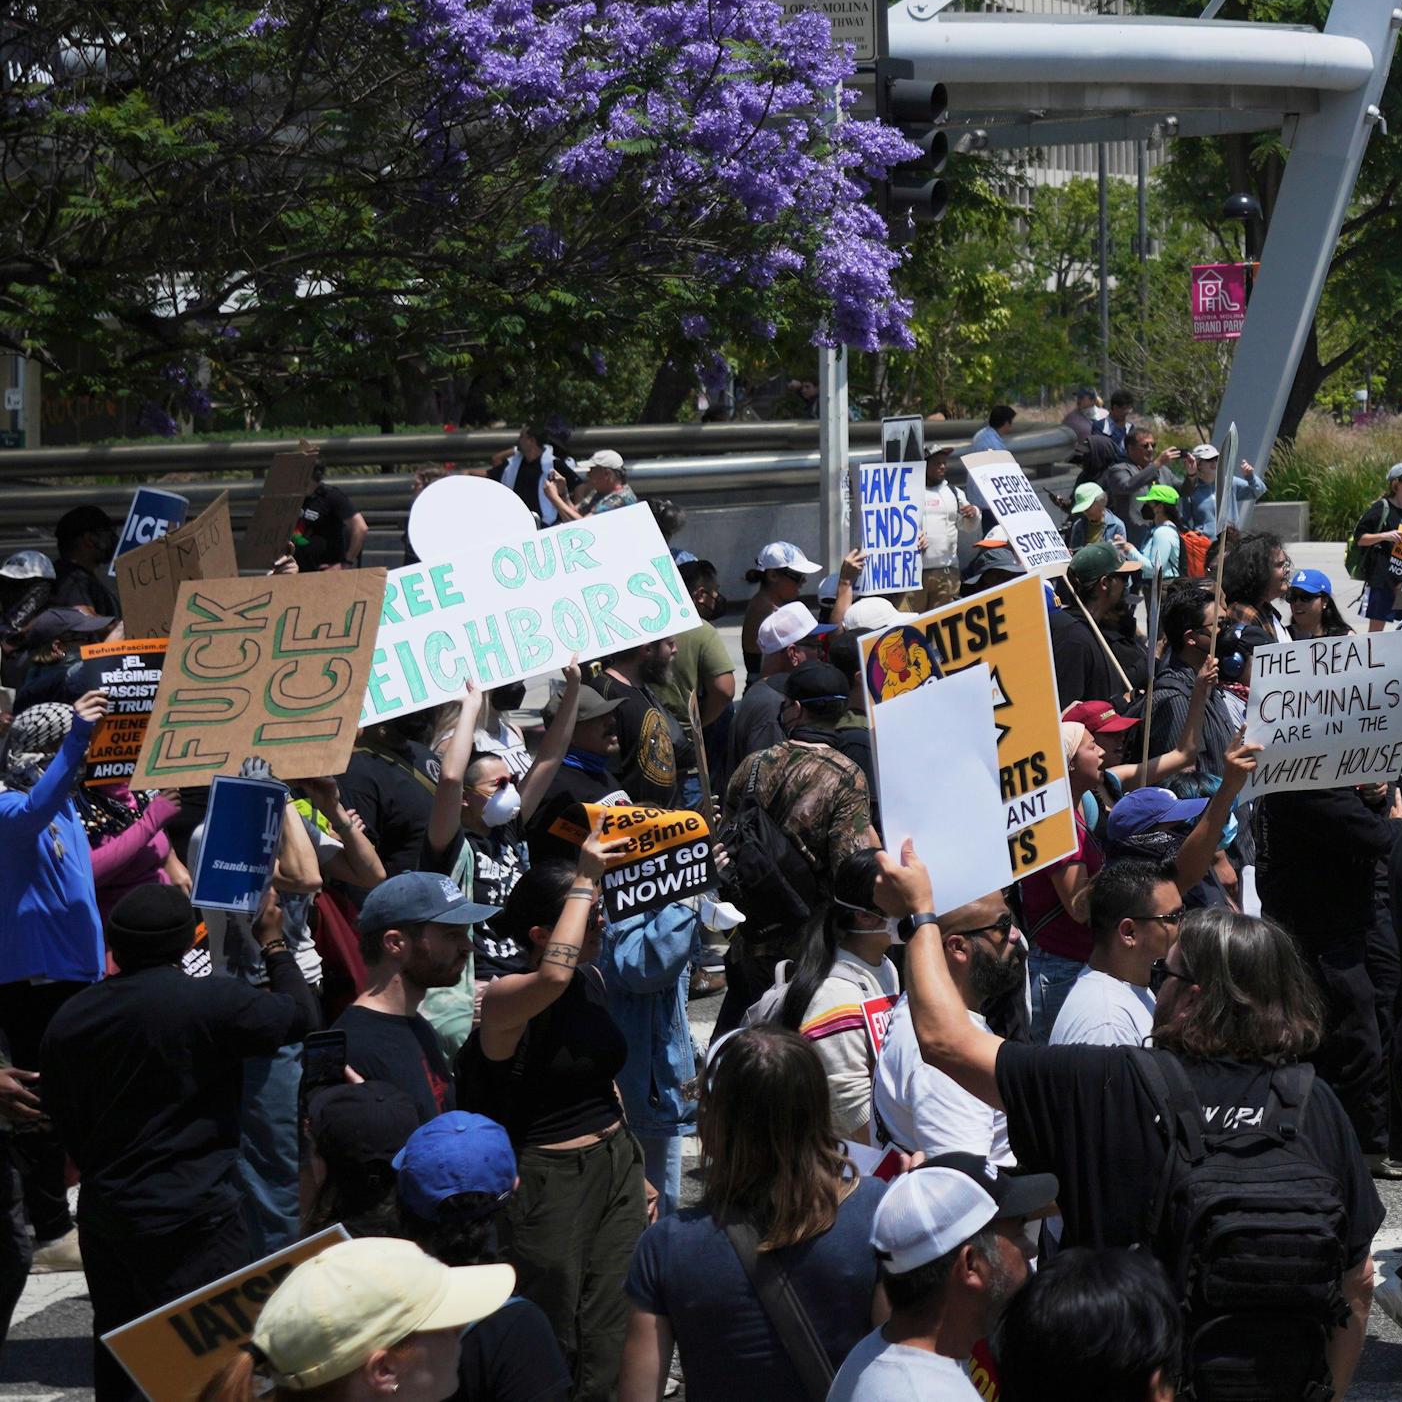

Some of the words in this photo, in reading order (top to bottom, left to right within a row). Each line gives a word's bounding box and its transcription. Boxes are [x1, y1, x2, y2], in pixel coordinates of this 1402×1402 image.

[823, 0, 869, 14] MOLINA
[832, 16, 866, 28] THWAY
[1194, 320, 1222, 334] GRAND
[1223, 319, 1245, 333] PARK
[990, 473, 1032, 496] PEOPLE
[125, 513, 169, 545] ICE
[1015, 533, 1045, 554] STOP
[128, 551, 166, 591] ICE
[491, 527, 602, 590] OUR
[379, 562, 466, 627] REE
[360, 554, 691, 721] EIGHBORS!
[924, 597, 1008, 666] ATSE
[88, 643, 169, 656] RefuseFascism.or
[1255, 650, 1301, 678] THE
[1309, 637, 1386, 676] REAL
[146, 590, 273, 777] FUCK
[253, 600, 368, 747] ICE
[98, 684, 159, 699] FASCIST
[118, 699, 156, 713] TRUM
[1259, 679, 1401, 724] CRIMINALS
[105, 718, 148, 731] TIENE
[110, 731, 141, 744] QUE
[1271, 724, 1312, 745] ARE
[1325, 720, 1344, 736] IN
[1358, 715, 1389, 733] THE
[93, 764, 135, 778] AHOR
[1250, 754, 1328, 788] WHITE
[625, 814, 701, 854] egime
[211, 859, 249, 873] Stands
[604, 854, 669, 891] MUST
[674, 842, 709, 866] GO
[615, 861, 708, 913] NOW!!!
